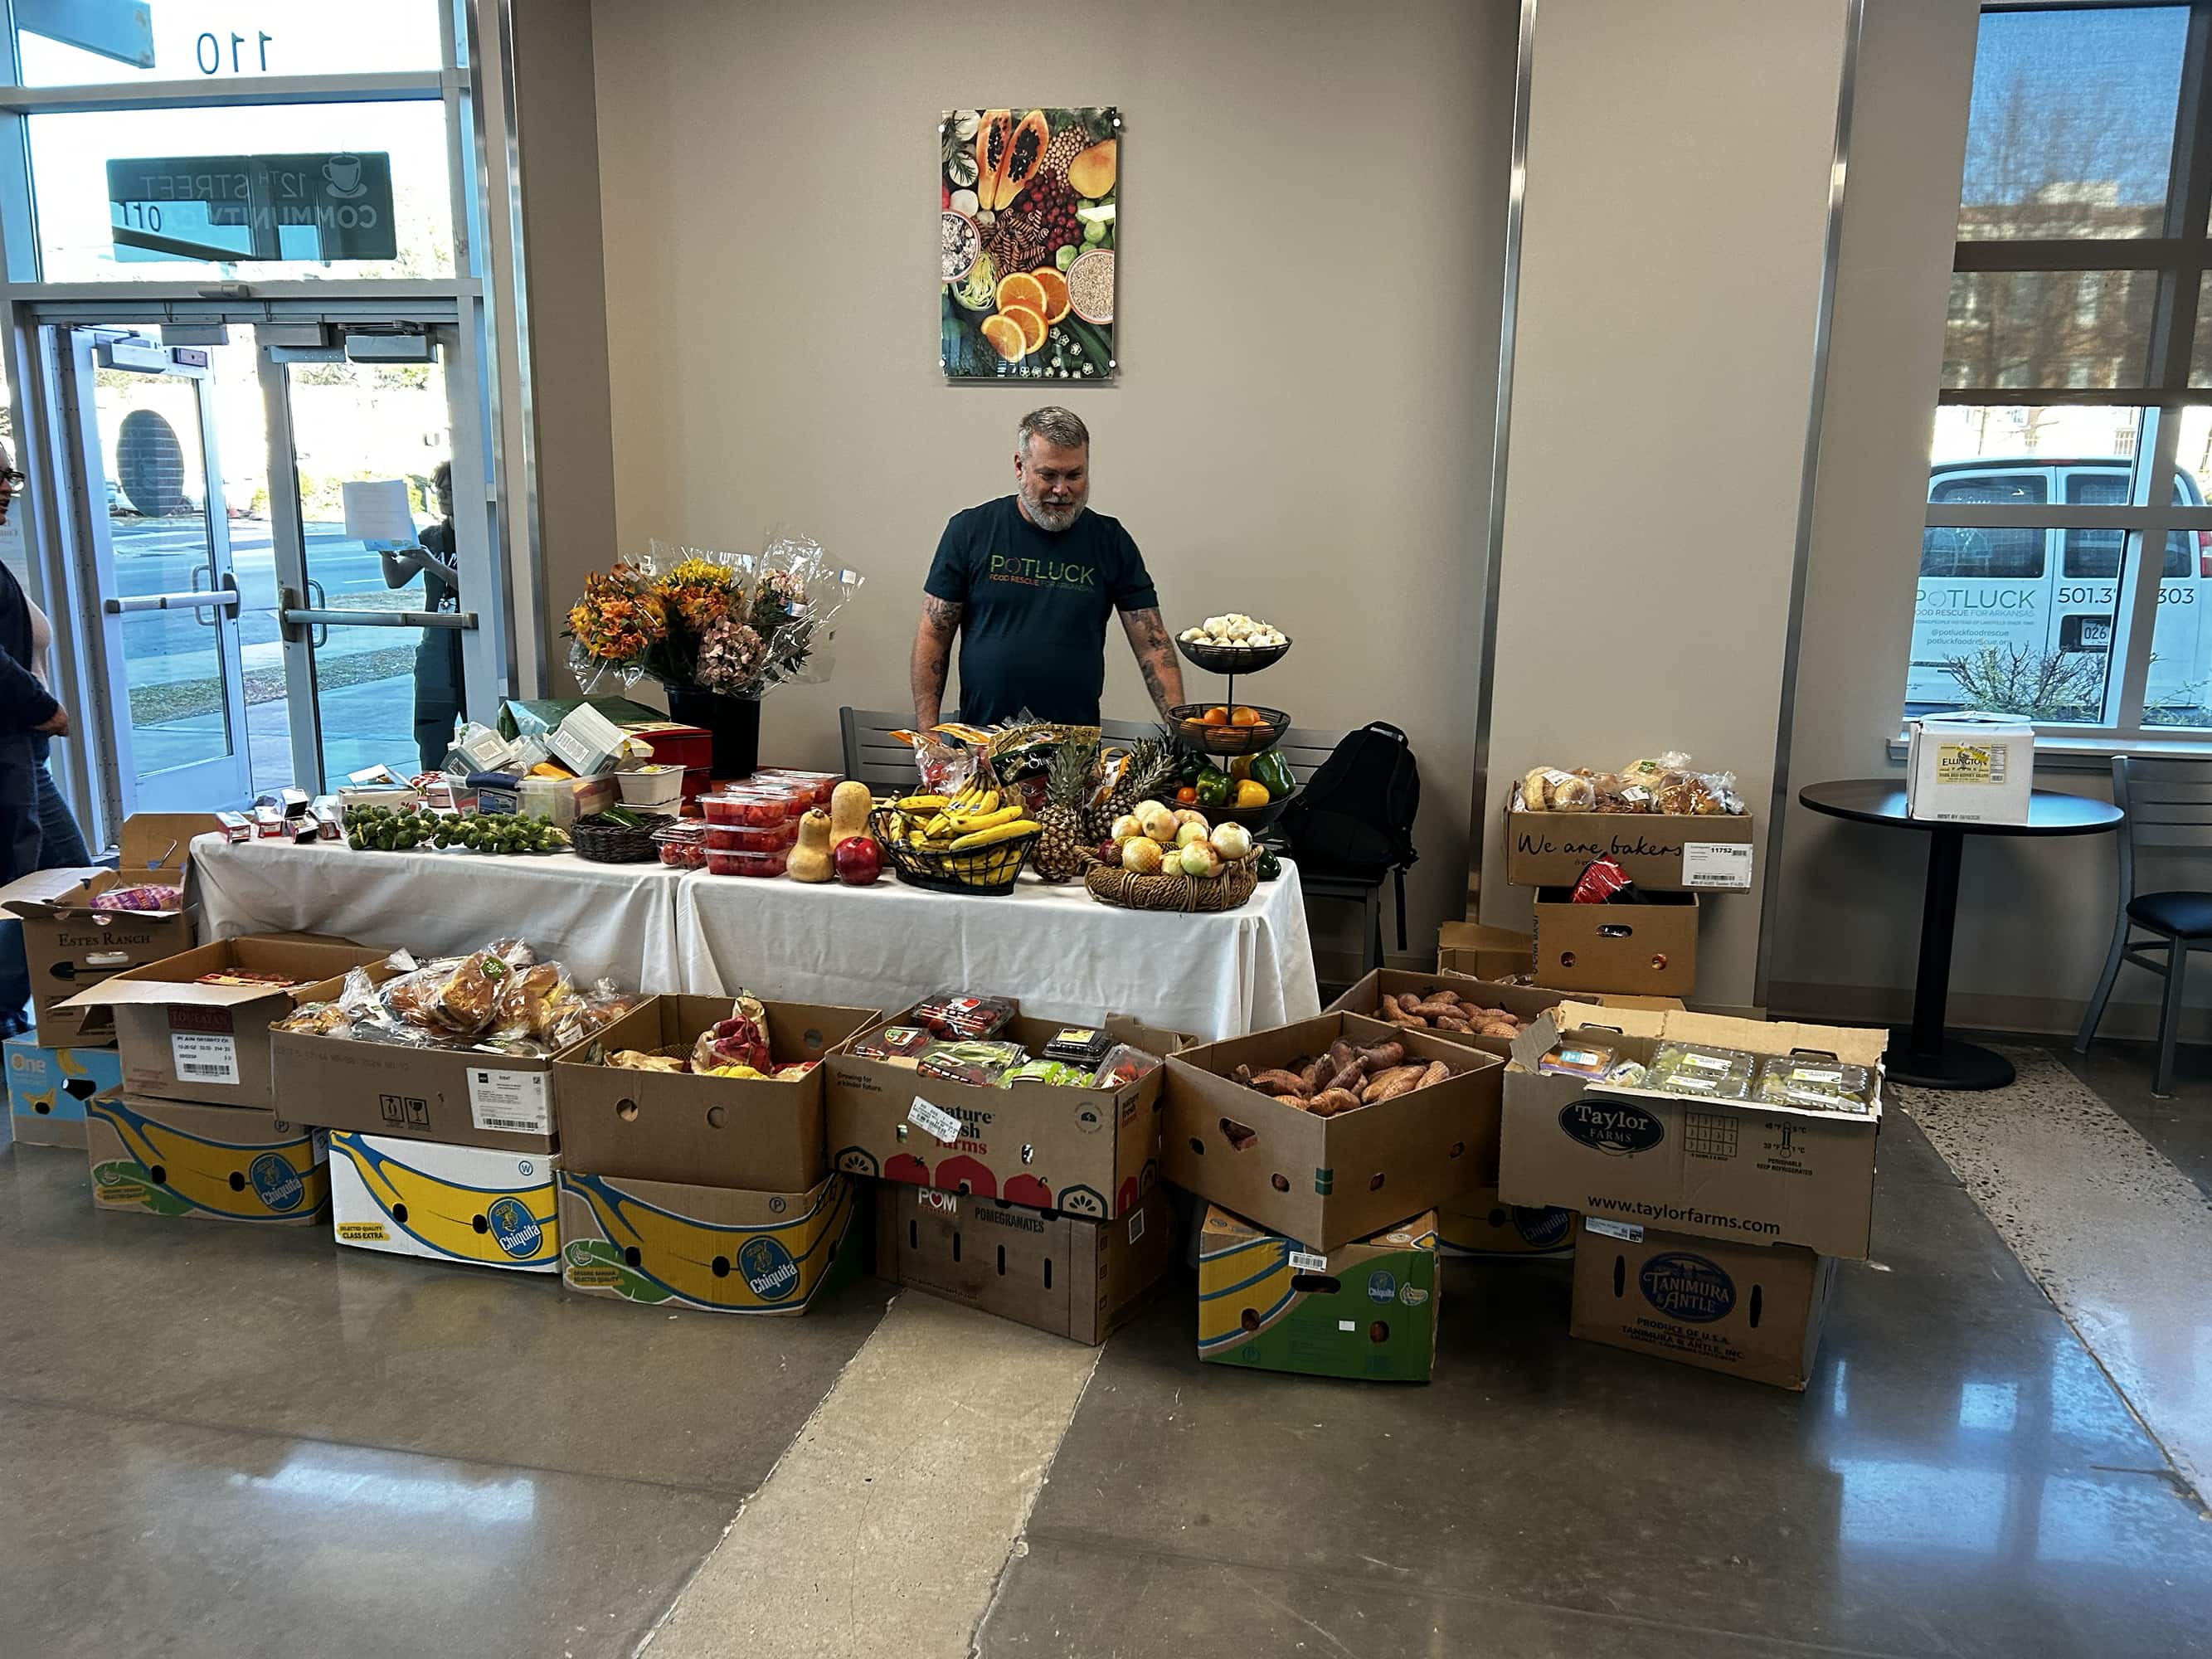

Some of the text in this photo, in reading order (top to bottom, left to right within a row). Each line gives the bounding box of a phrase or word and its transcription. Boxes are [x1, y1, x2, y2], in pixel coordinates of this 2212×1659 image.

[989, 573, 1009, 581] FOOD
[1010, 576, 1039, 586] RESCUE
[990, 555, 1096, 586] POTLUCK
[2058, 587, 2116, 604] 501.3
[1931, 629, 2010, 637] @potluckfoodrescue
[1518, 832, 1557, 855] We
[1563, 841, 1603, 855] are
[1610, 834, 1683, 857] bakers
[58, 932, 151, 947] ESTES RANCH
[1575, 1105, 1650, 1131] Taylor
[1590, 1128, 1632, 1142] FARMS
[260, 1178, 304, 1206] Chiquita
[918, 1187, 957, 1214] POM
[975, 1207, 1045, 1233] POMEGRANATES
[1587, 1195, 1781, 1235] www.taylorfarms.com
[498, 1224, 541, 1253] Chiquita
[749, 1262, 798, 1296] Chiquita
[1643, 1272, 1729, 1302] TANIMURA
[1660, 1292, 1716, 1313] ANTLE
[1621, 1326, 1674, 1343] TANIMURA
[1636, 1317, 1683, 1332] PRODUCE
[1686, 1328, 1699, 1336] OF
